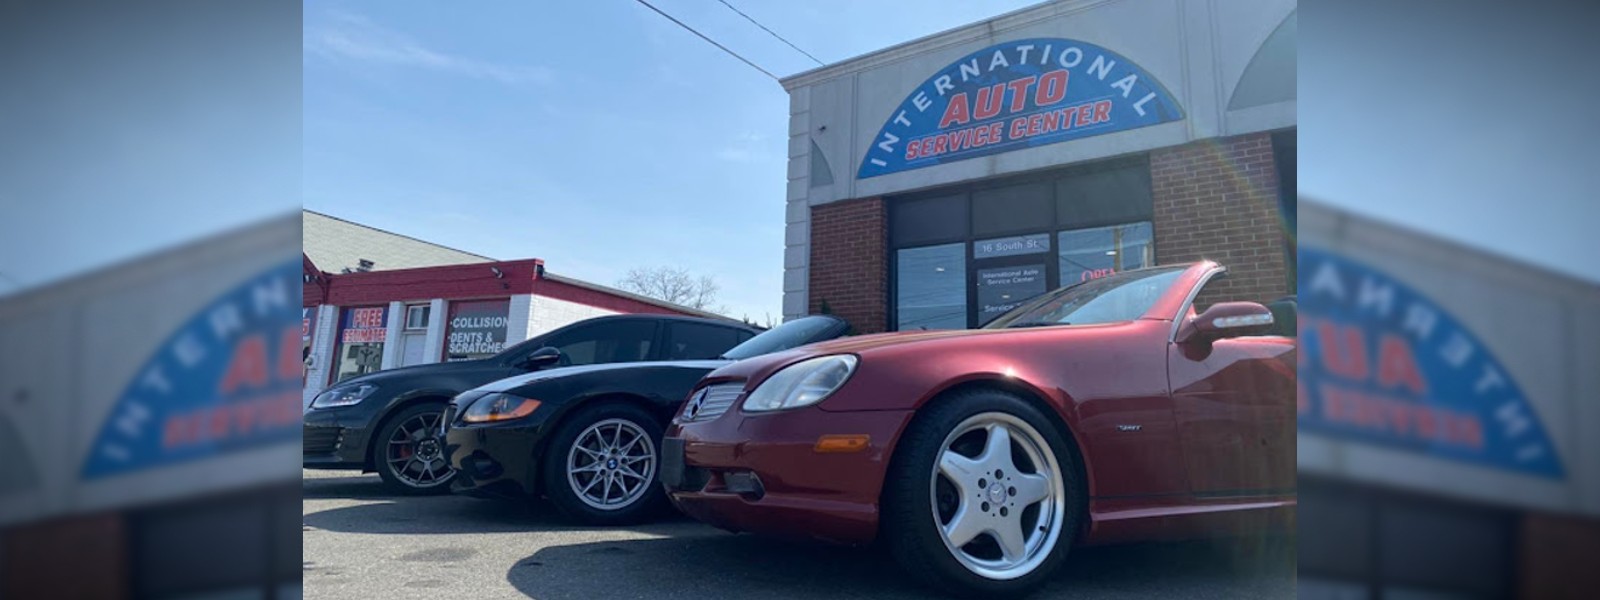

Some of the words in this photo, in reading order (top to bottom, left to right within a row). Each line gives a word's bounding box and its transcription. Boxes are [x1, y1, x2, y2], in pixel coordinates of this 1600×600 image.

[871, 44, 1157, 167] INTERNATIONAL
[939, 69, 1068, 129] AUTO
[905, 121, 1003, 160] SERVICE
[1010, 99, 1113, 140] CENTER
[983, 244, 993, 253] 16
[996, 241, 1023, 251] South
[1027, 239, 1038, 249] St
[983, 270, 1021, 279] International
[1023, 269, 1039, 277] Auto
[987, 278, 1011, 286] Service
[1012, 276, 1035, 284] Center
[984, 304, 1014, 313] Service
[353, 307, 383, 328] FREE
[453, 316, 509, 329] COLLISION
[450, 332, 483, 343] DENTS
[485, 331, 493, 343] &
[449, 342, 507, 353] SCRATCHES
